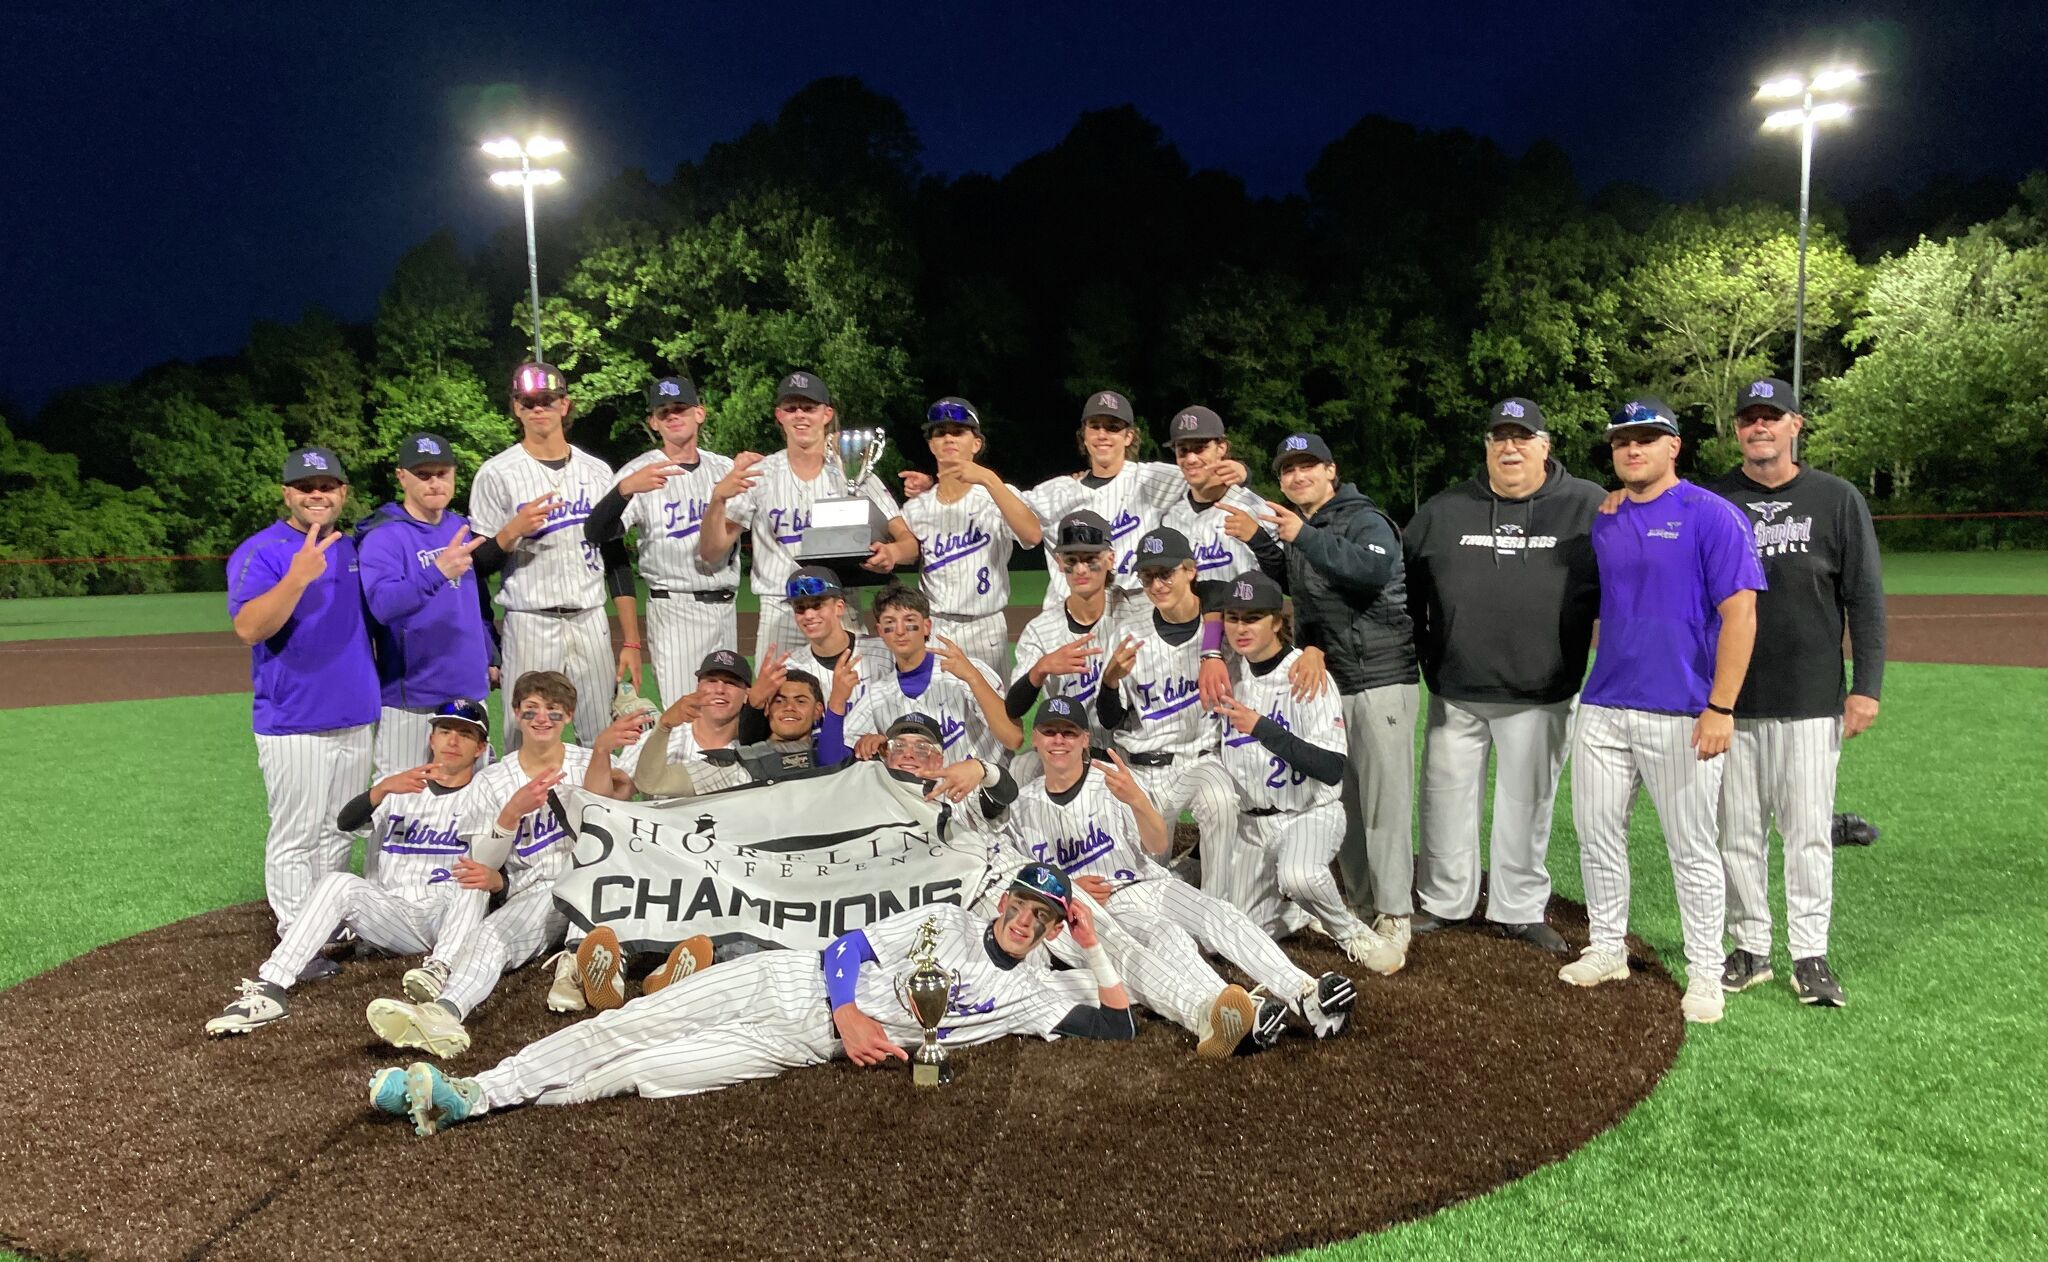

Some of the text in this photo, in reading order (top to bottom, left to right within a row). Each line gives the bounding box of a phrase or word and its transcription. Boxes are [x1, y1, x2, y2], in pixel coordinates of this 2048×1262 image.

[1143, 535, 1164, 554] NB
[1459, 534, 1558, 549] THUNDERBRDS
[1758, 543, 1809, 558] EBALL
[976, 567, 991, 595] 8
[1048, 699, 1071, 715] NB
[383, 814, 464, 847] T-birds
[571, 804, 931, 870] SHORELIN
[1032, 821, 1110, 865] T-birds
[628, 837, 944, 878] CNFERENC
[590, 875, 963, 938] CHAMPIONS
[835, 968, 844, 978] 4
